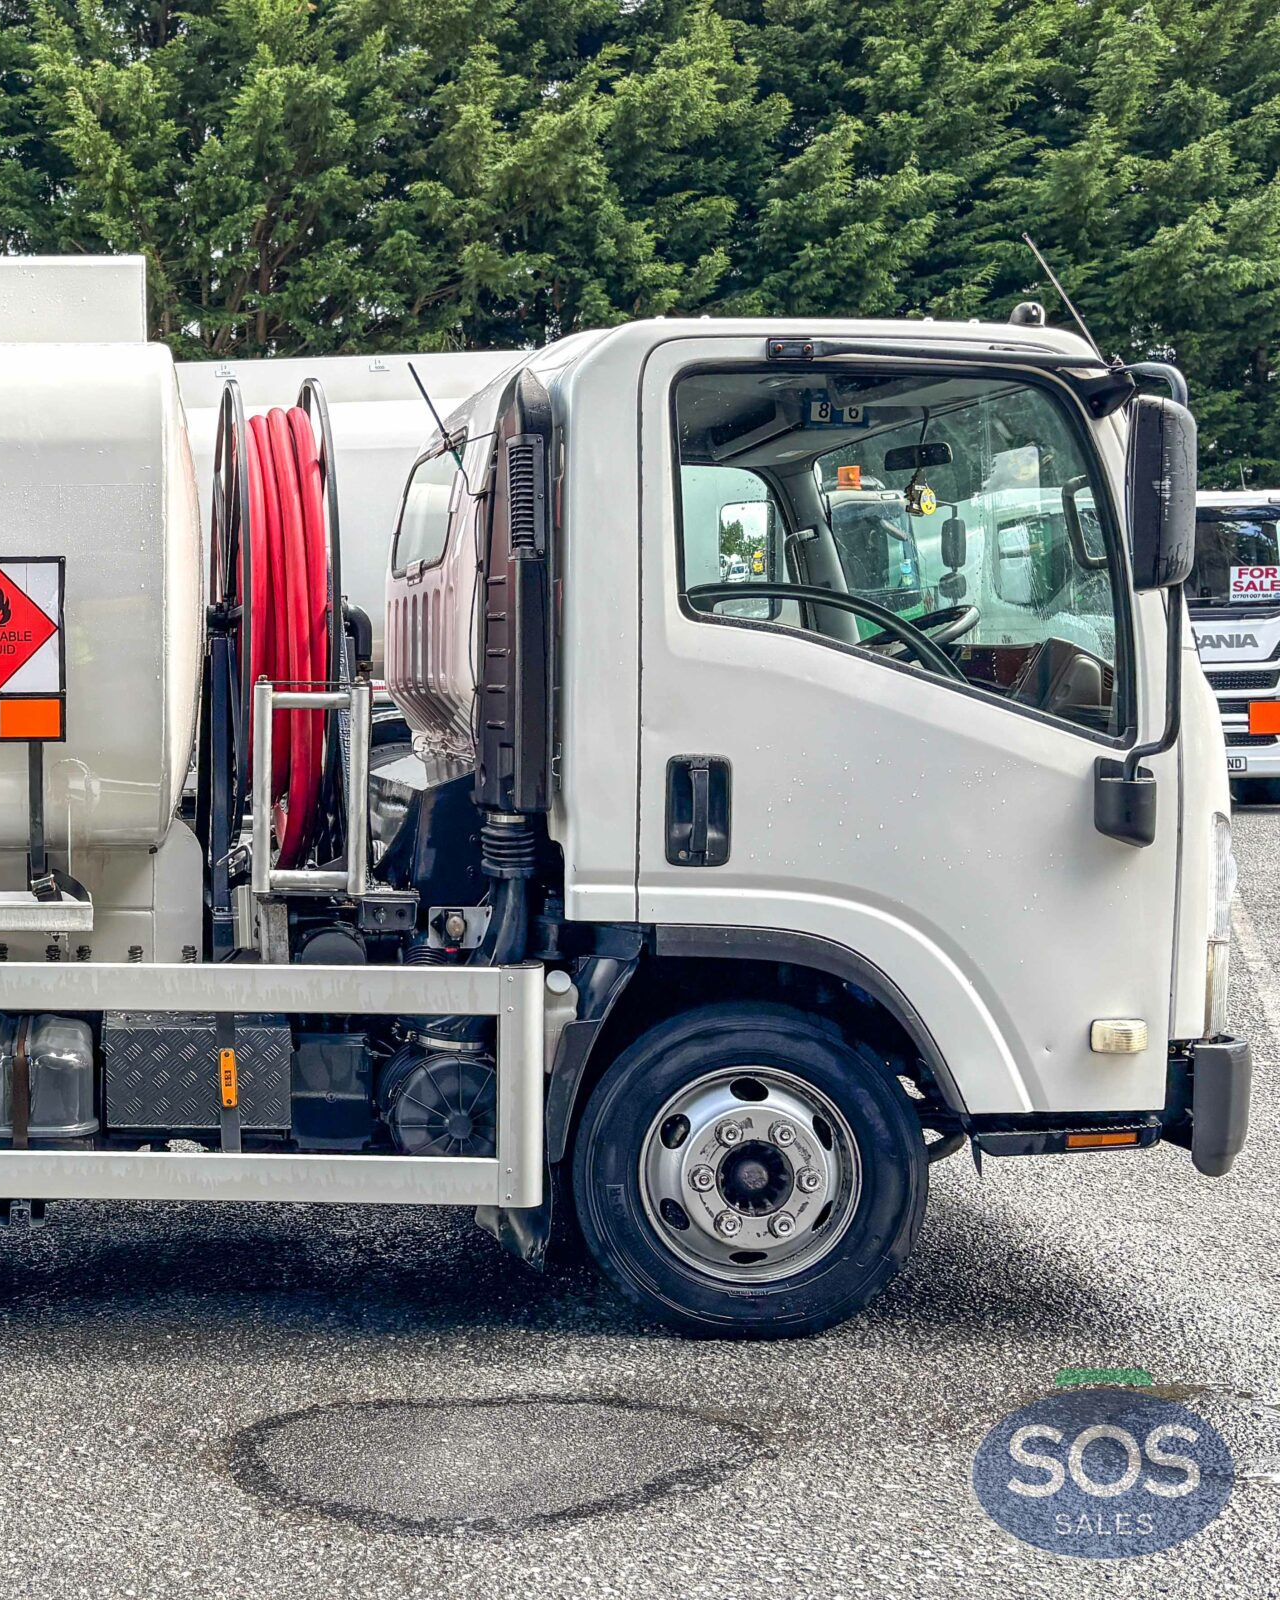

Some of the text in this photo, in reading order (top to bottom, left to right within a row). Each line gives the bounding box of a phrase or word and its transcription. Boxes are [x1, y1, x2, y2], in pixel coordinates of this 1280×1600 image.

[818, 402, 829, 419] 8
[1237, 567, 1278, 579] FOR
[1232, 580, 1280, 592] SALE
[1196, 634, 1259, 649] ANIA
